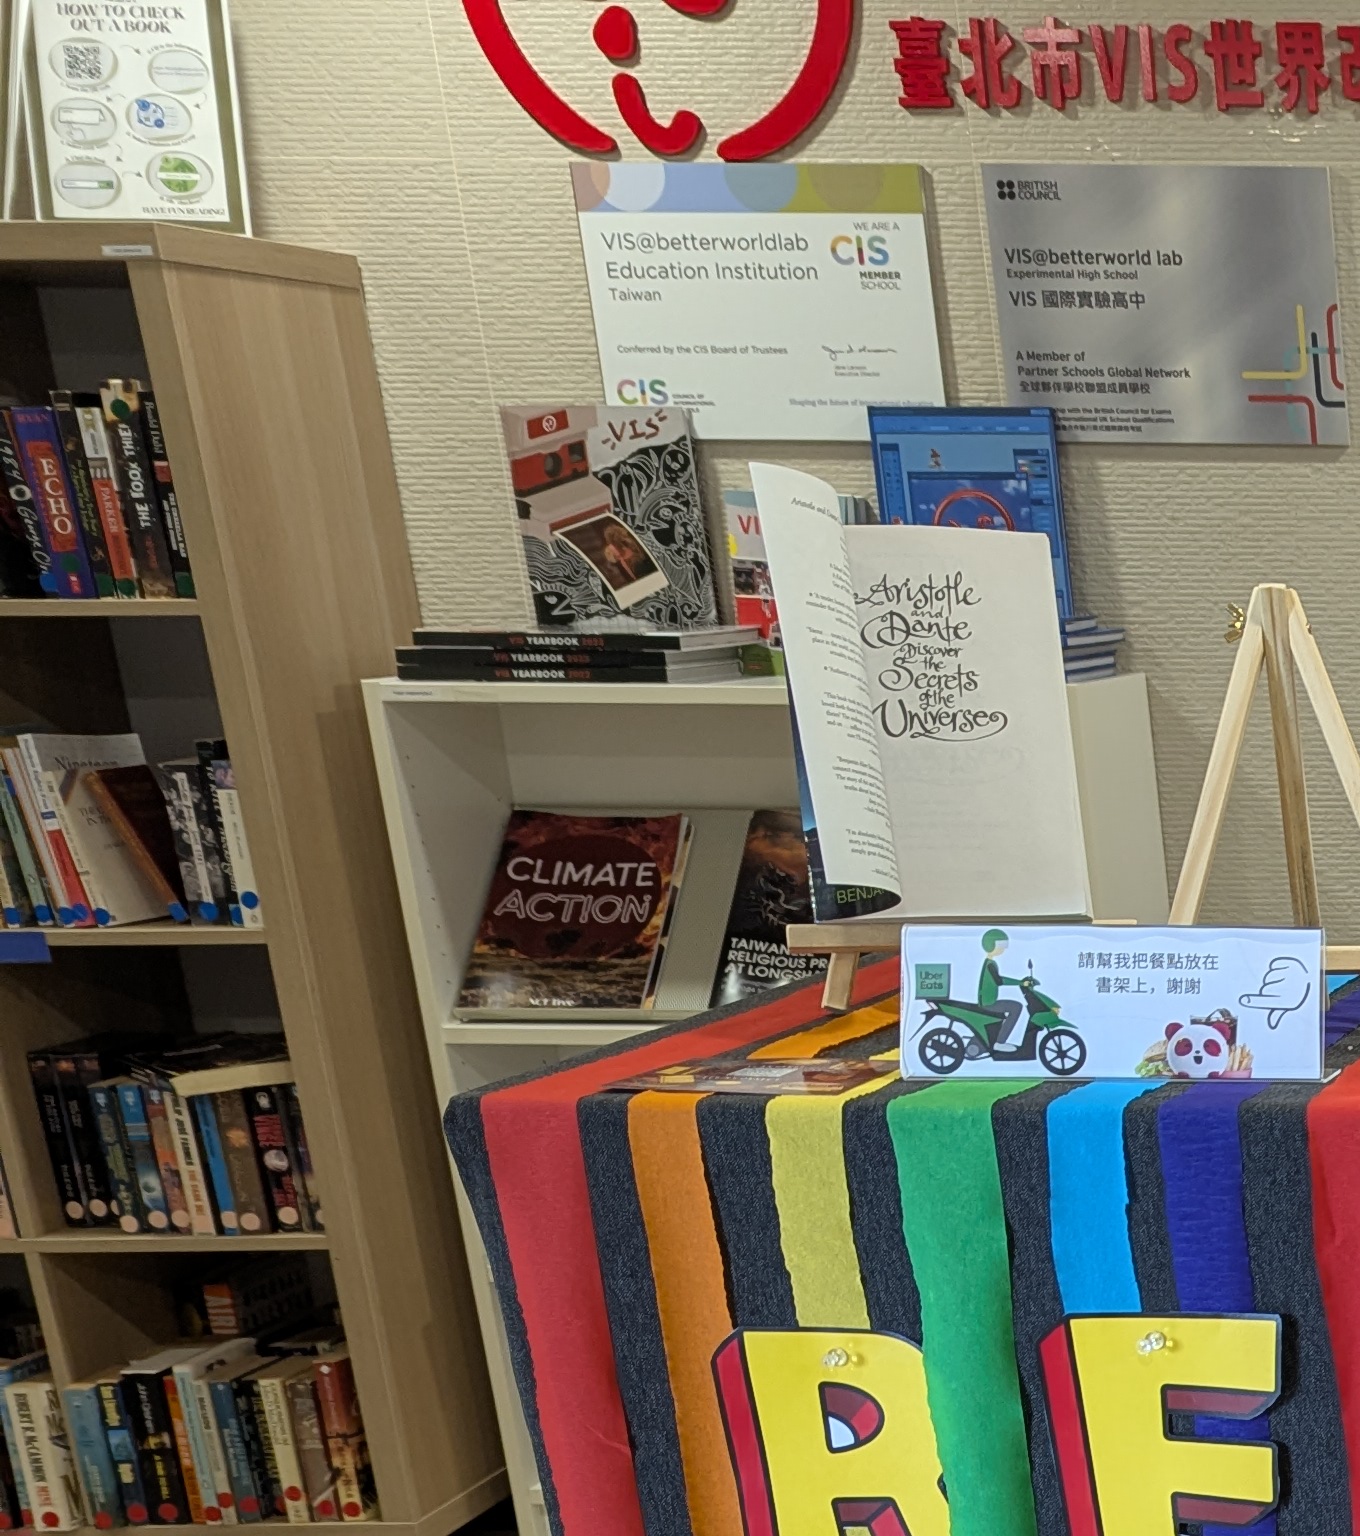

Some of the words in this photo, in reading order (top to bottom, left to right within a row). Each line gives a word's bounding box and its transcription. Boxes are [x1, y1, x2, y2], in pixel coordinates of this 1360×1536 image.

[56, 3, 98, 17] HOW
[104, 5, 130, 17] TO
[131, 6, 186, 20] CHECK
[70, 19, 104, 31] OUT
[109, 20, 122, 32] A
[124, 20, 172, 33] BOOK
[1017, 180, 1059, 191] BRITISH
[1018, 190, 1062, 201] COUNCIL
[601, 231, 809, 254] VIS@betterworldlab
[830, 235, 890, 266] CIS
[1004, 248, 1151, 266] VIS@betterworld
[1157, 249, 1183, 266] lab
[606, 262, 708, 280] Education
[716, 262, 819, 280] Institution
[1007, 269, 1074, 281] Experimental
[1078, 270, 1100, 282] High
[1104, 270, 1138, 281] School
[609, 288, 662, 301] Taiwan
[1009, 290, 1037, 307] VIS
[1042, 290, 1146, 310] 國際實驗高中
[1018, 366, 1058, 377] Partner
[1062, 366, 1104, 378] Schools
[1108, 367, 1142, 378] Global
[1145, 368, 1191, 379] Network
[617, 379, 669, 405] CIS
[39, 458, 74, 535] ECHO
[853, 571, 982, 616] Aristotle
[911, 606, 944, 618] and
[860, 610, 973, 649] Dante
[526, 636, 580, 647] YEARBOOK
[511, 653, 565, 663] YEARBOOK
[893, 642, 964, 660] Discover
[919, 656, 947, 672] the
[511, 669, 566, 679] YEARBOOK
[878, 657, 980, 697] Secrets
[872, 699, 1008, 742] Universe
[506, 856, 658, 888] CLIMATE
[494, 889, 651, 925] ACTION
[1078, 951, 1219, 971] 請幫我把餐點放在
[919, 971, 944, 982] Uber
[919, 981, 944, 991] Eats
